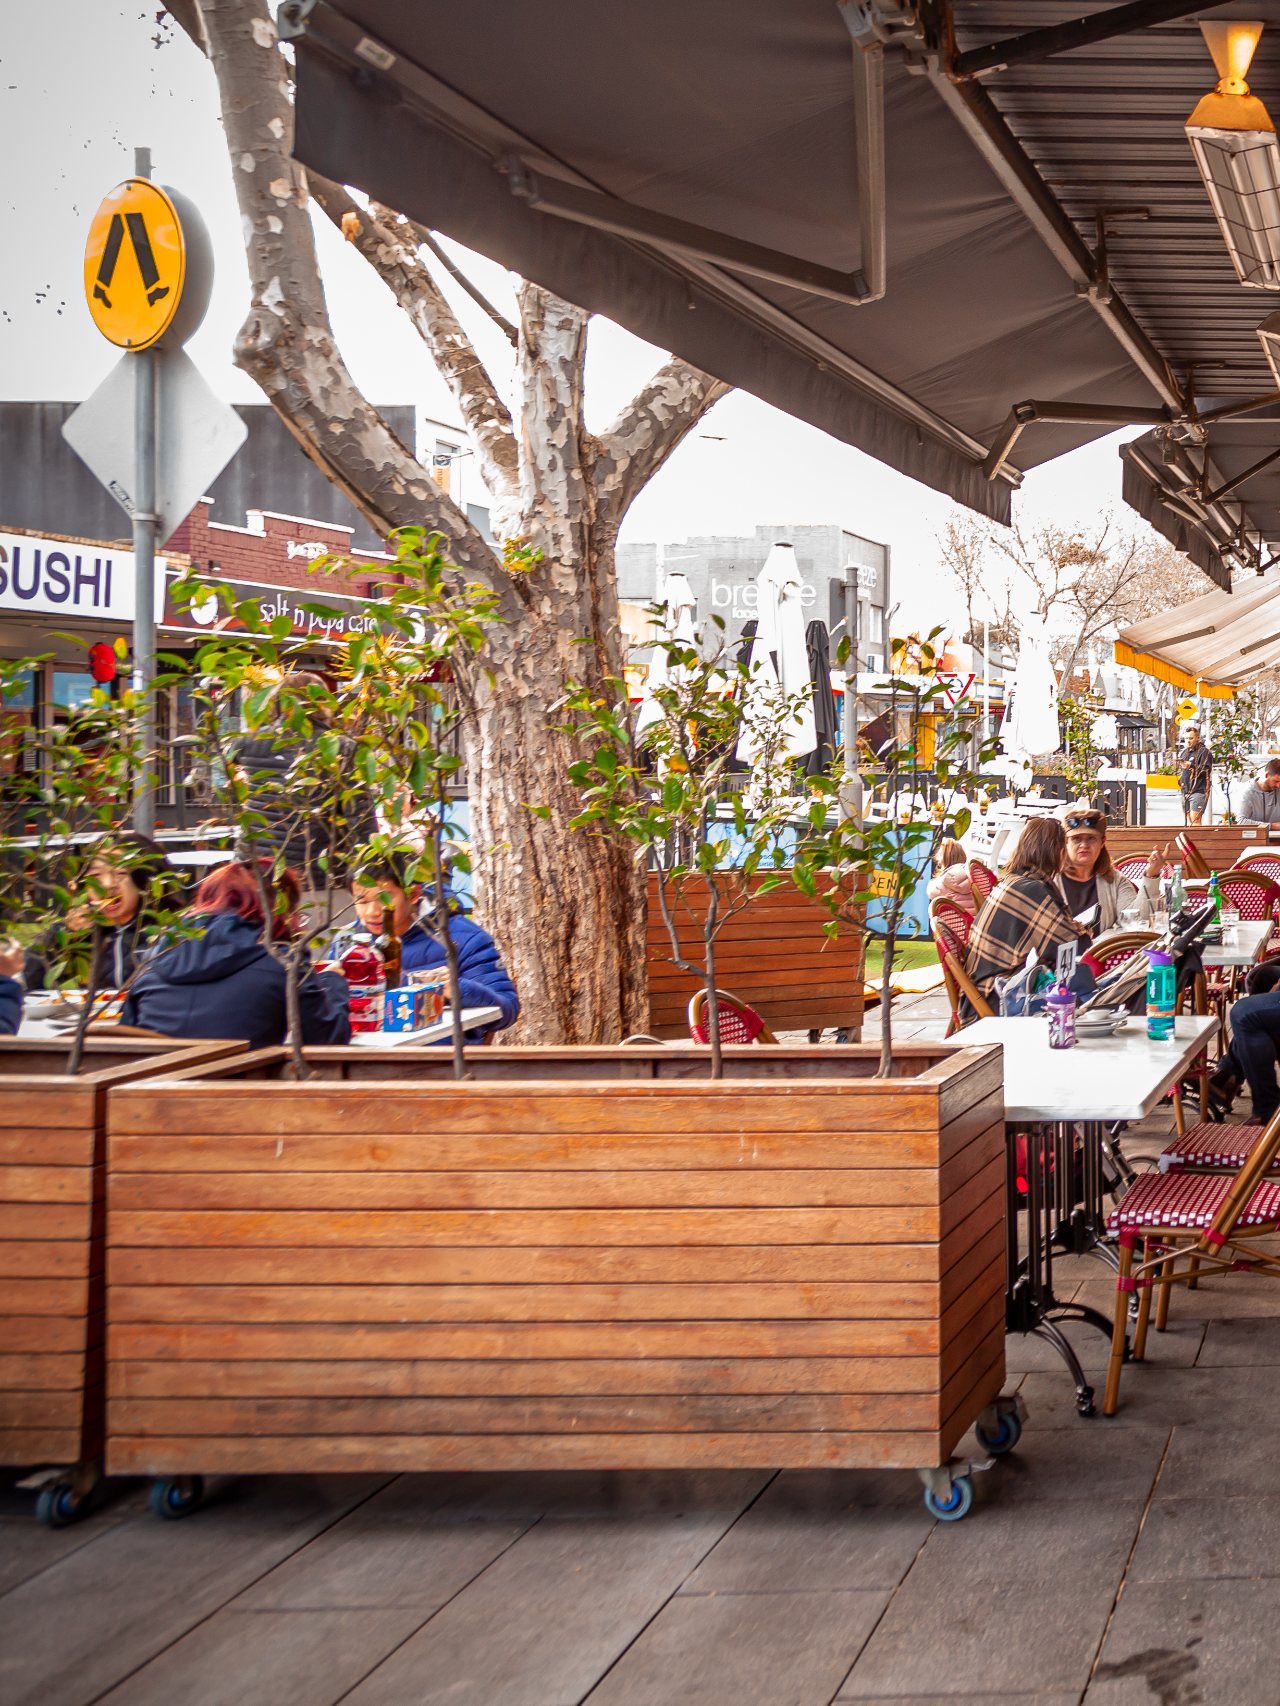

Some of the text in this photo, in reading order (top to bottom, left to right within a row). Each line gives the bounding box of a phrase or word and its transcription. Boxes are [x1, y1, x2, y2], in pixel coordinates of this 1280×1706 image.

[0, 544, 112, 608] USHI
[259, 594, 290, 622] salt
[293, 608, 305, 627] n
